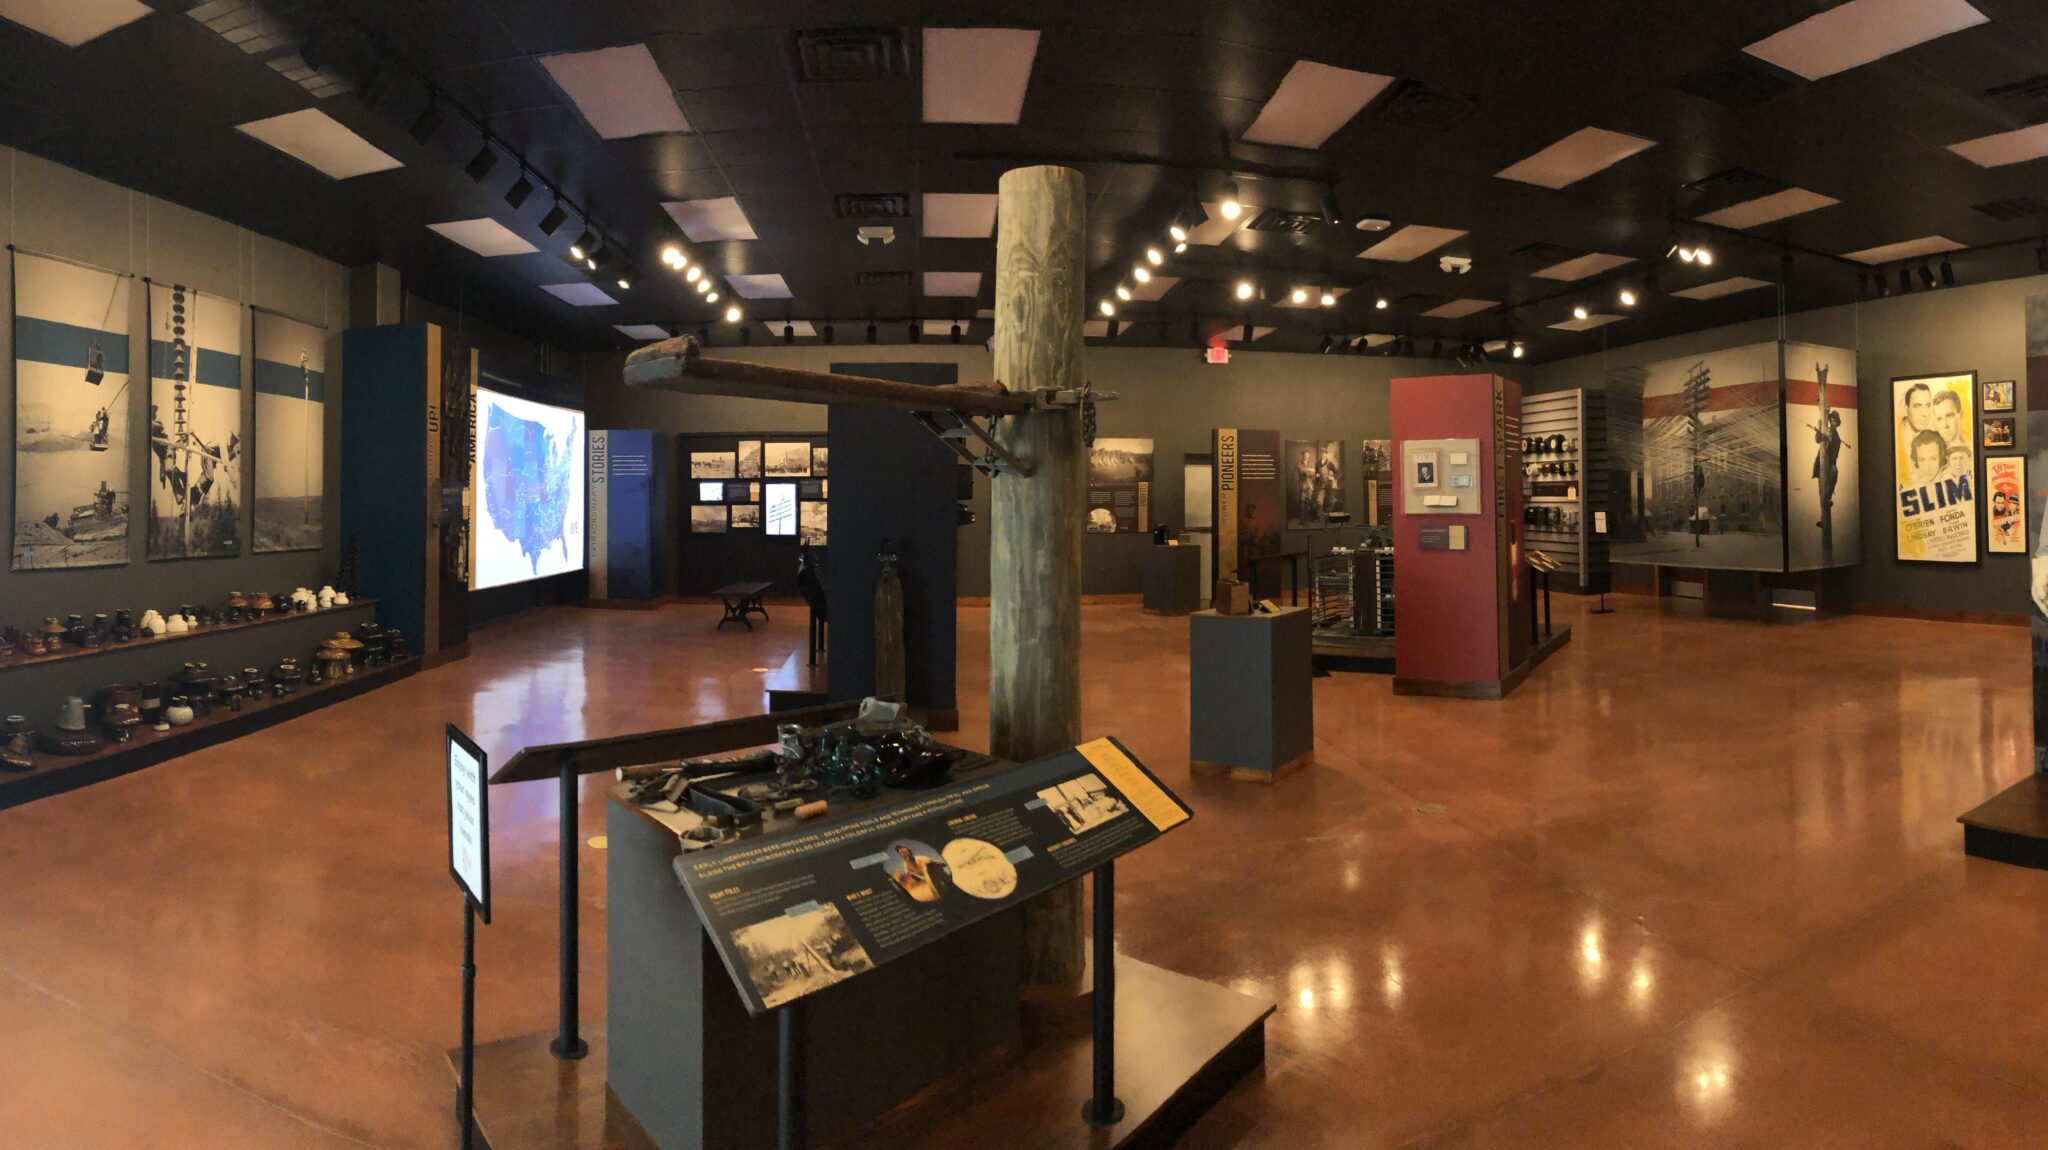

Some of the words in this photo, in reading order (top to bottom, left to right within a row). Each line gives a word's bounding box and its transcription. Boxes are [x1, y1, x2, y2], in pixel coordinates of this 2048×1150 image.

[430, 405, 438, 432] UP!
[1496, 390, 1504, 454] SPARK
[592, 436, 605, 484] STORIES
[1221, 435, 1234, 490] PIONEERS
[1497, 466, 1505, 518] FIRST
[1905, 518, 1935, 532] O'BRIEN
[1940, 510, 1966, 524] FONDA
[1906, 530, 1936, 542] LINDSAY
[1942, 521, 1968, 534] ERWIN
[692, 860, 716, 870] EARLY
[762, 844, 779, 853] WERE
[698, 867, 722, 878] ALONG
[795, 845, 813, 854] ALSO
